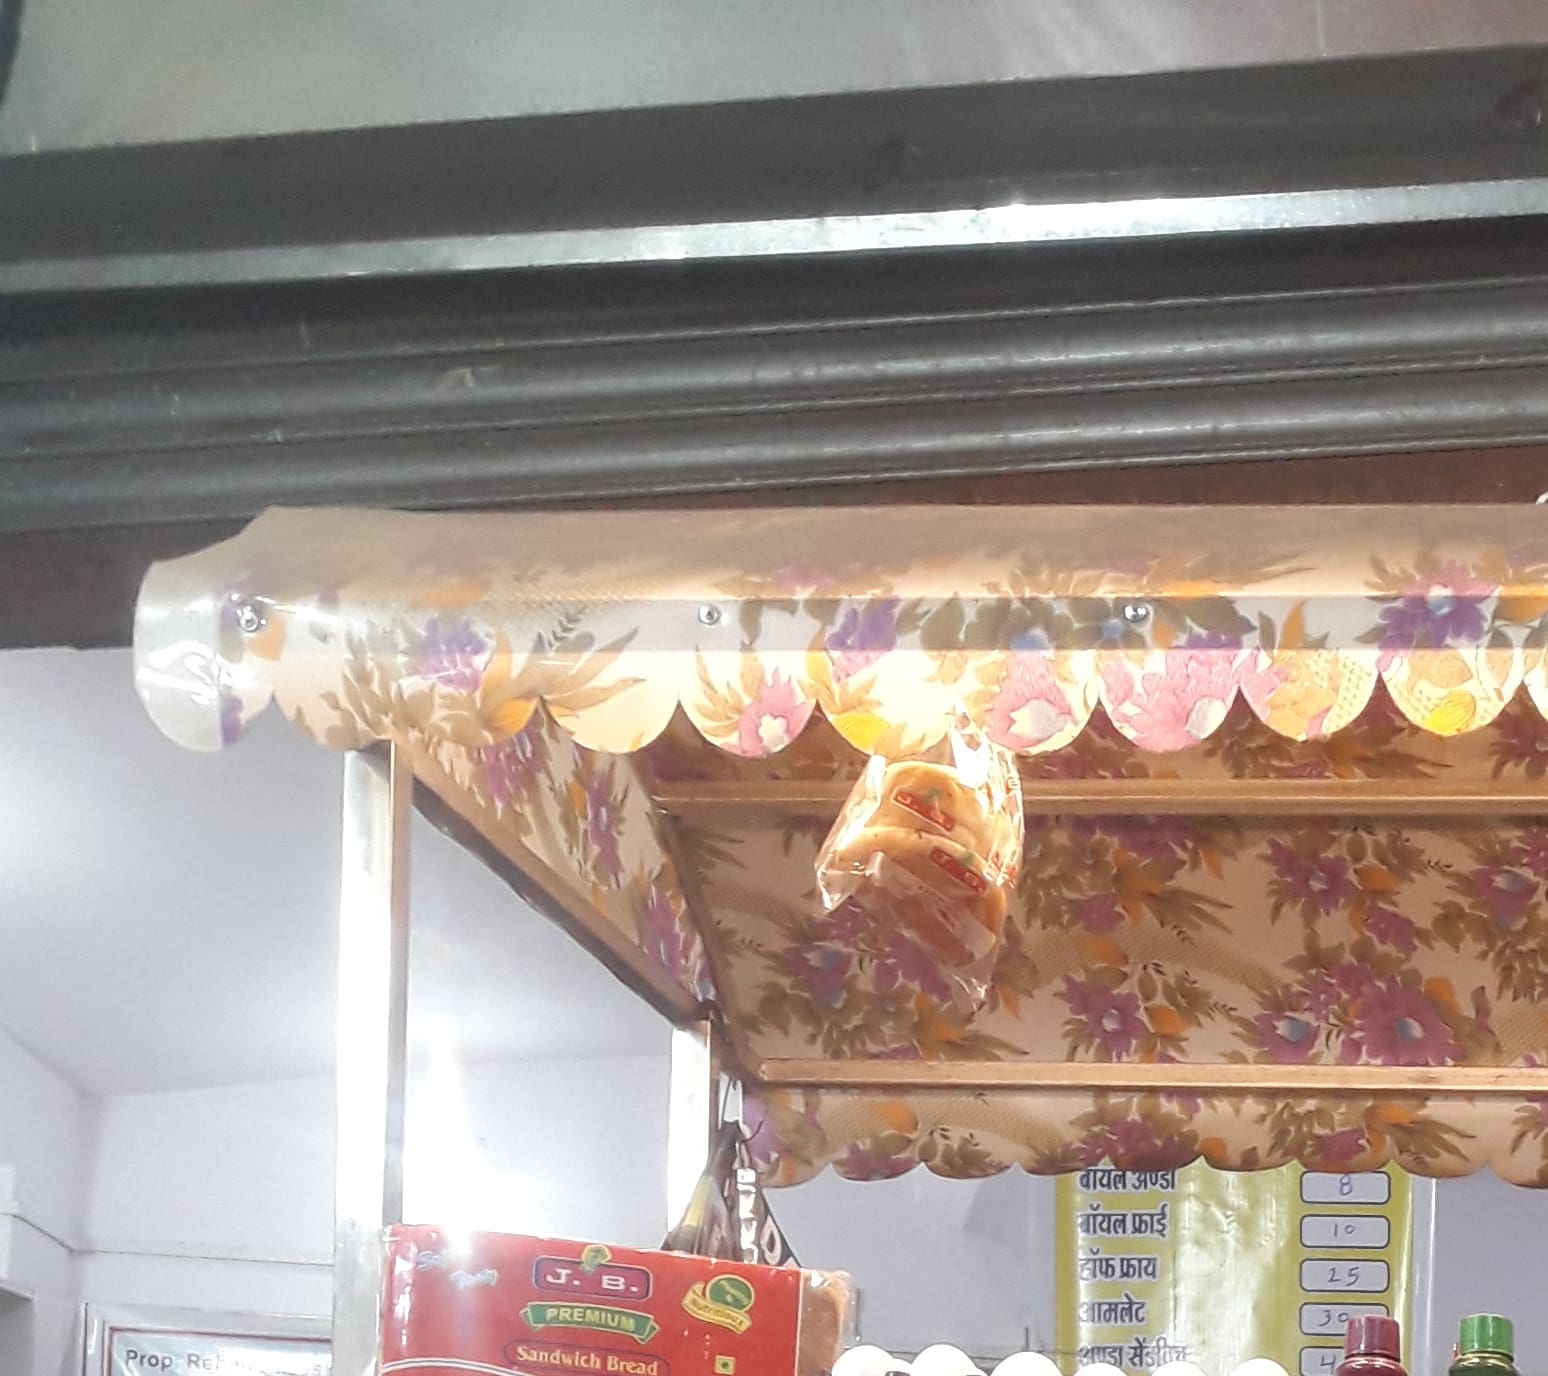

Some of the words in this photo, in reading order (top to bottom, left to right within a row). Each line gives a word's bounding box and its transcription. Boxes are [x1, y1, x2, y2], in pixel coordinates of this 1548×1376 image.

[1339, 1174, 1353, 1196] 8
[1333, 1223, 1356, 1237] 10
[1328, 1266, 1360, 1287] 25
[544, 1306, 637, 1331] PREMIUM
[515, 1345, 601, 1370] Sandwich
[606, 1354, 659, 1376] Bread
